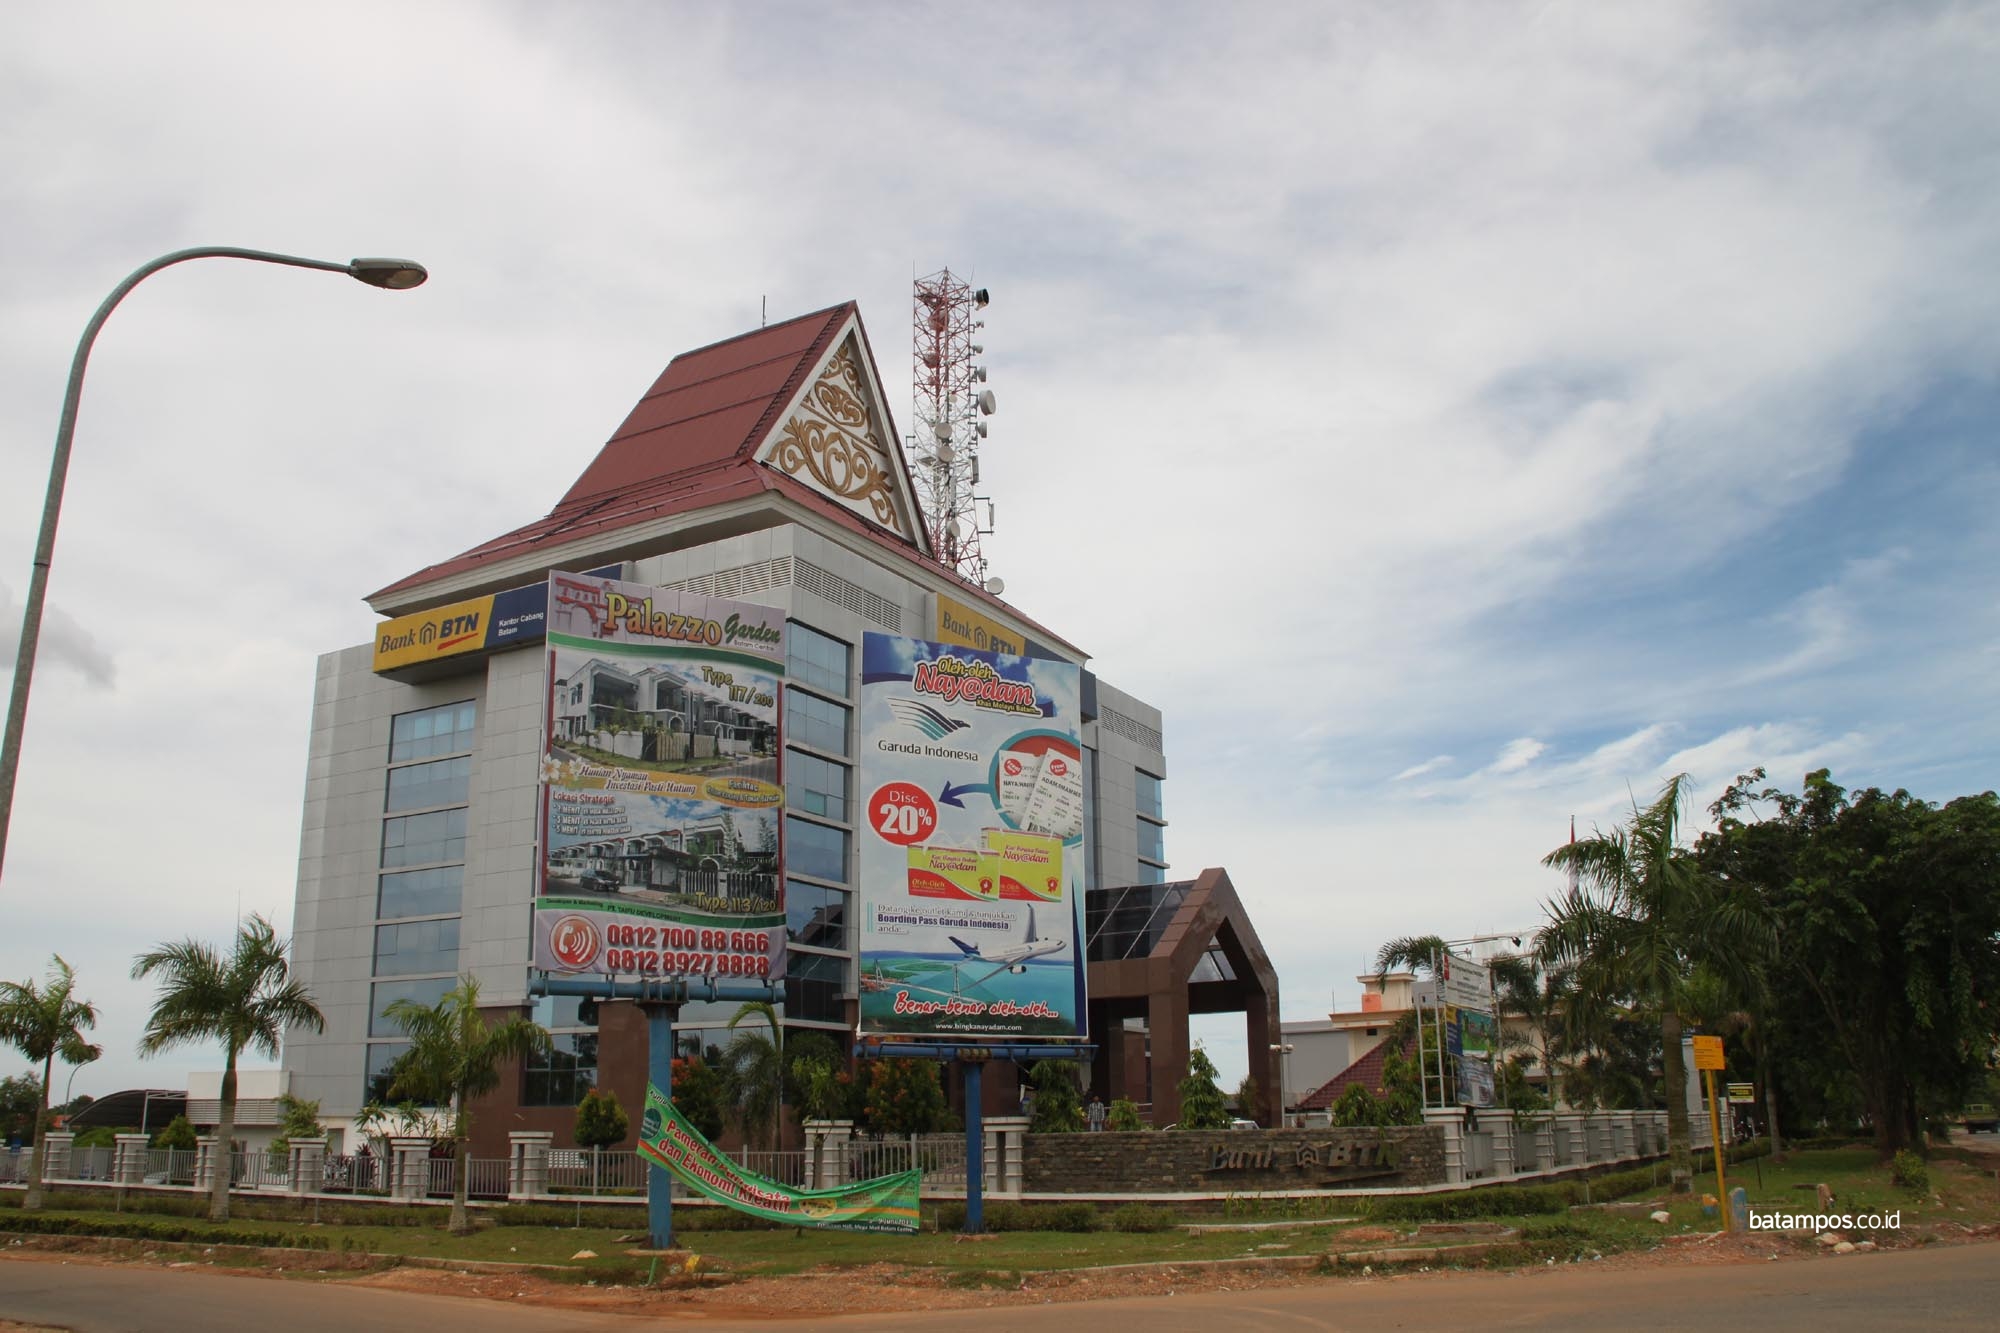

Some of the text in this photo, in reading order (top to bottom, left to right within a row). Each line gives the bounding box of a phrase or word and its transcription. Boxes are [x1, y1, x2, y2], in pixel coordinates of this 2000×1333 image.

[498, 611, 544, 628] Kantor Cabang
[603, 592, 781, 646] Palazzo Garden
[380, 612, 480, 653] Bank BTN
[497, 626, 518, 637] Batam
[942, 610, 1017, 656] Bank BTN
[702, 666, 733, 688] Type
[938, 657, 993, 678] Oleh-oleh
[915, 665, 1034, 705] Nay@dam
[878, 740, 979, 761] Garuda Indonesia
[579, 765, 612, 778] Hunian
[552, 791, 615, 805] Lokasi Strategis
[889, 790, 918, 804] Disc
[880, 803, 932, 836] 20%
[929, 859, 977, 872] Nay@dam
[1003, 850, 1049, 864] Nay@dam
[695, 891, 728, 914] Type
[878, 914, 1009, 929] Boarding Pass Garuda Indonesia
[607, 924, 770, 953] 0812 700 88 666
[607, 949, 770, 976] 0812 8927 8888
[894, 991, 986, 1015] Benar-benar
[665, 1118, 718, 1167] Pameran
[657, 1137, 682, 1161] dan
[681, 1150, 736, 1195] Ekonomi
